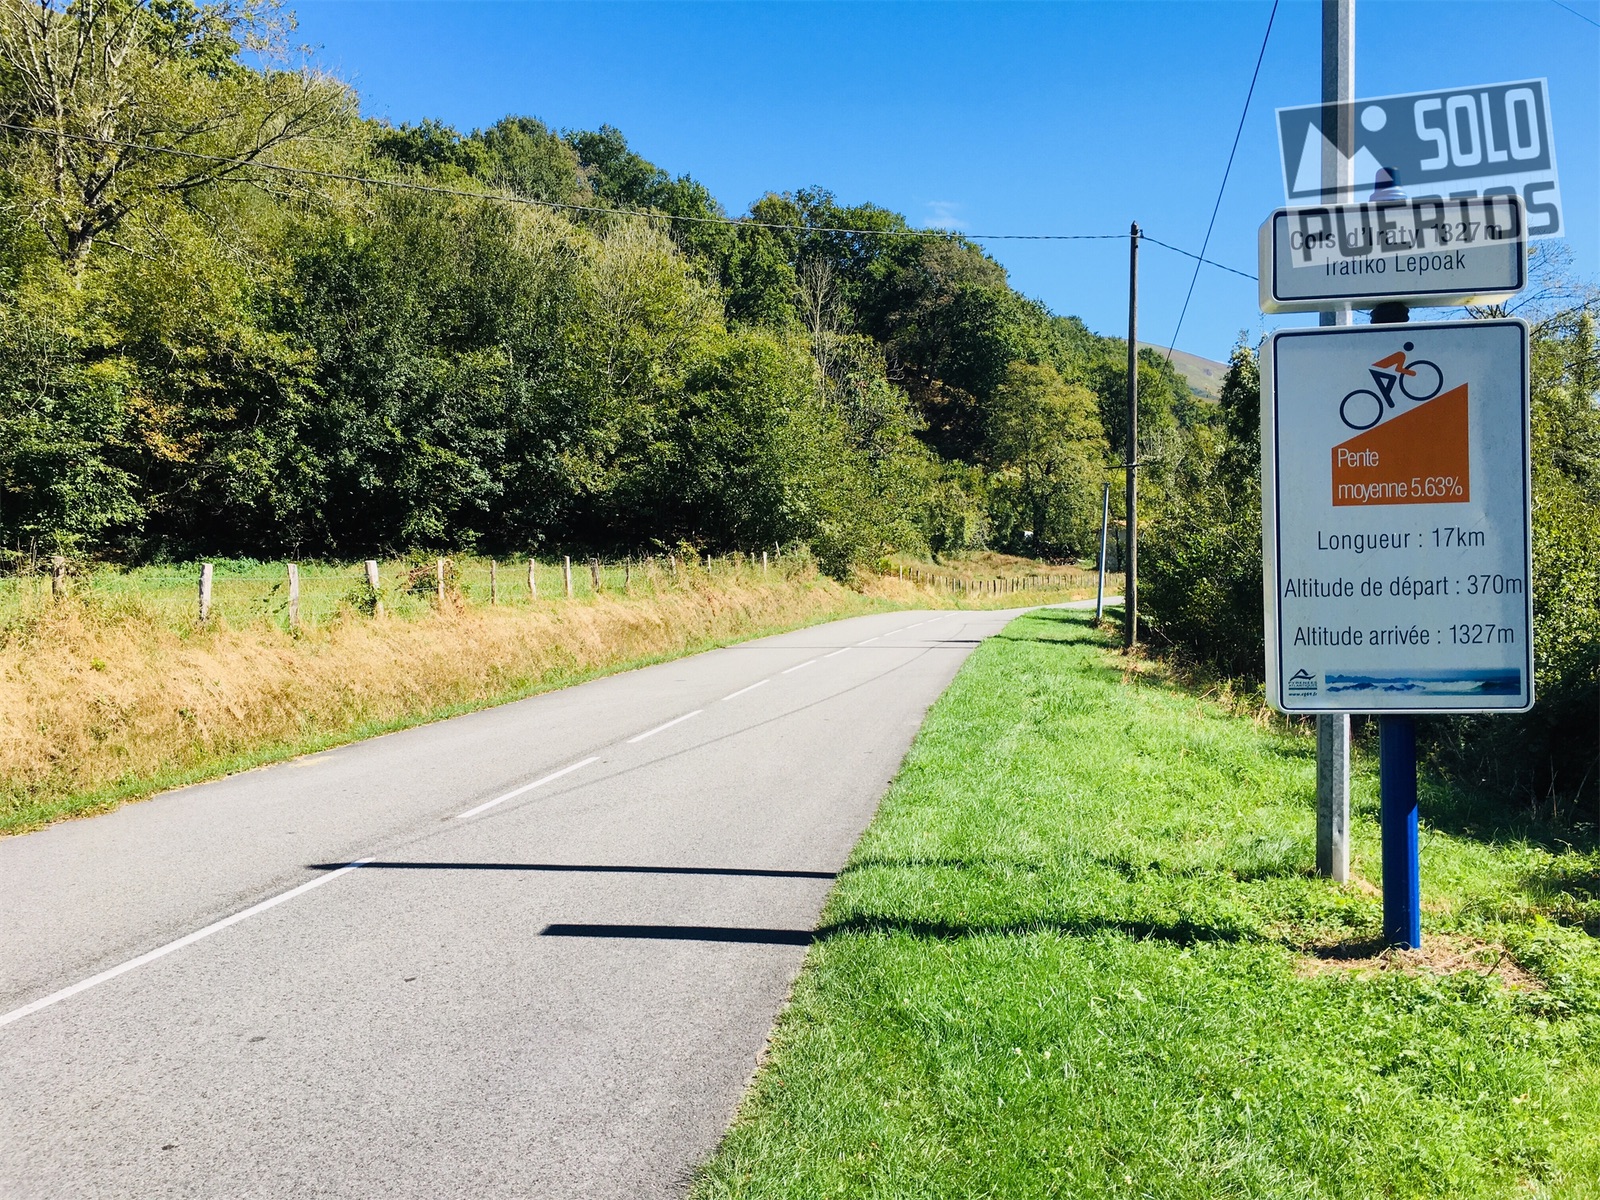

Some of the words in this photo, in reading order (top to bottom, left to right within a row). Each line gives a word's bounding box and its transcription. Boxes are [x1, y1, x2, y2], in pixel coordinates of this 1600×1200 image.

[1290, 229, 1336, 251] Cols
[1431, 221, 1503, 244] 1327m
[1325, 255, 1387, 276] Iratiko
[1395, 251, 1466, 275] Lepoak
[1337, 448, 1379, 468] Pente
[1338, 481, 1407, 502] moyenne
[1411, 476, 1463, 497] 5.63%
[1317, 530, 1411, 553] Longueur
[1432, 527, 1485, 547] 17km
[1284, 577, 1354, 598] Altitude
[1360, 577, 1382, 597] de
[1389, 576, 1449, 600] départ
[1467, 574, 1522, 595] 370m
[1294, 626, 1363, 646] Altitude
[1369, 624, 1430, 645] arrivée
[1449, 624, 1515, 644] 1327m
